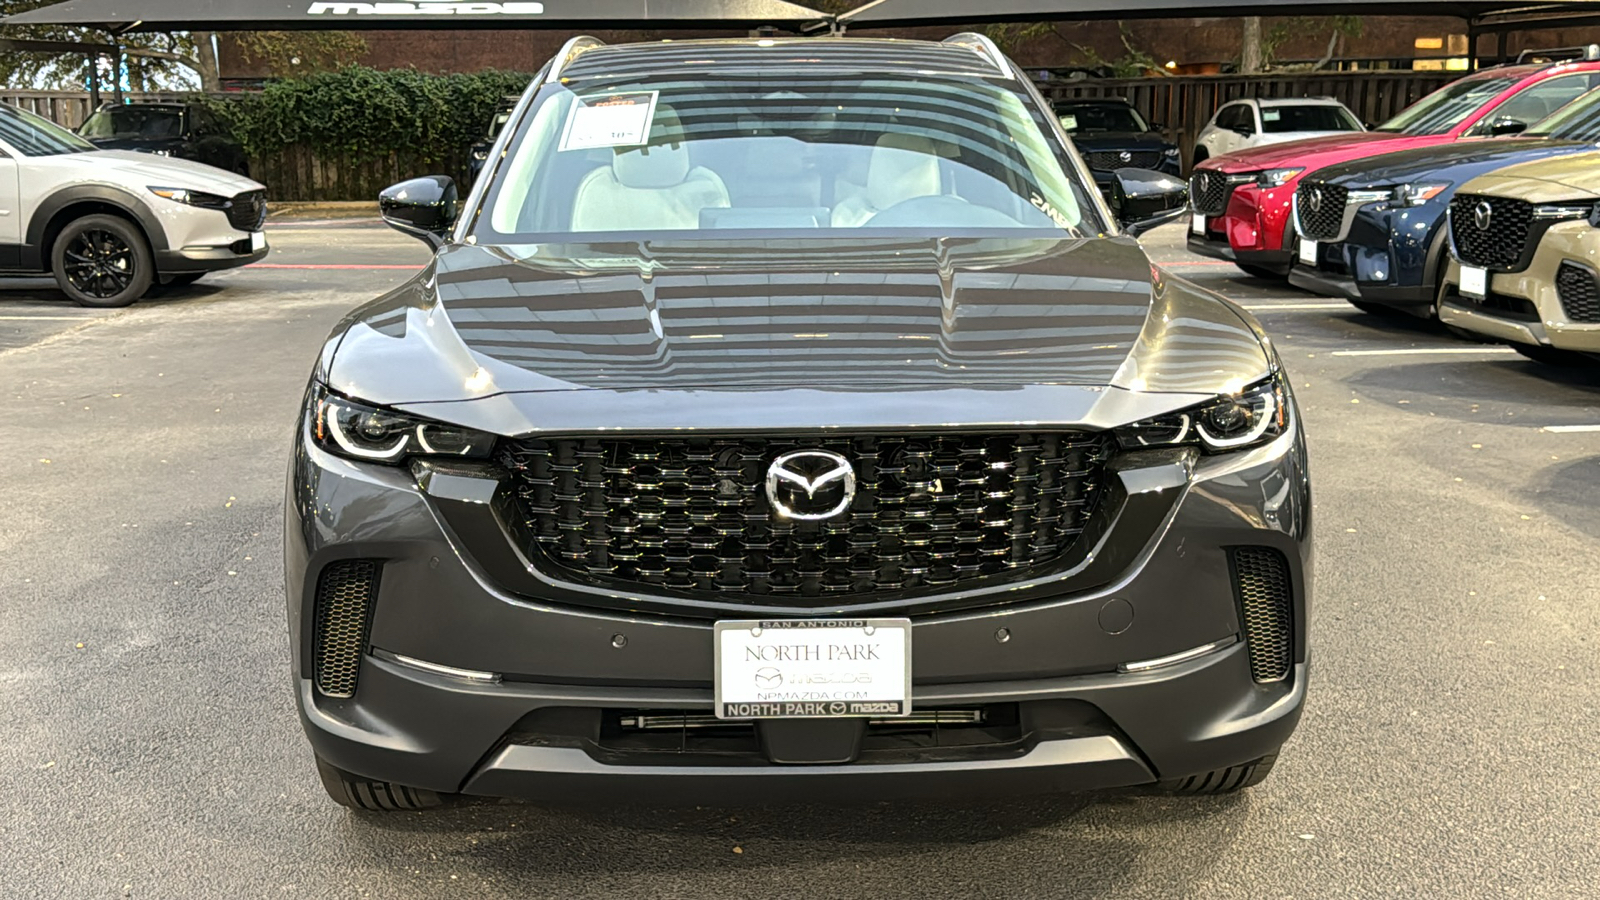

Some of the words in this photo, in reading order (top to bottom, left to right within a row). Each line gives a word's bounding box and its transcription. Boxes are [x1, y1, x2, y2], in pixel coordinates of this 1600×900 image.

[799, 620, 864, 628] ANTONIO
[745, 645, 820, 661] NORTH
[829, 644, 880, 660] PARK
[757, 691, 867, 700] NPMAZDACOM
[727, 703, 781, 716] NORTH
[786, 702, 826, 715] PARK
